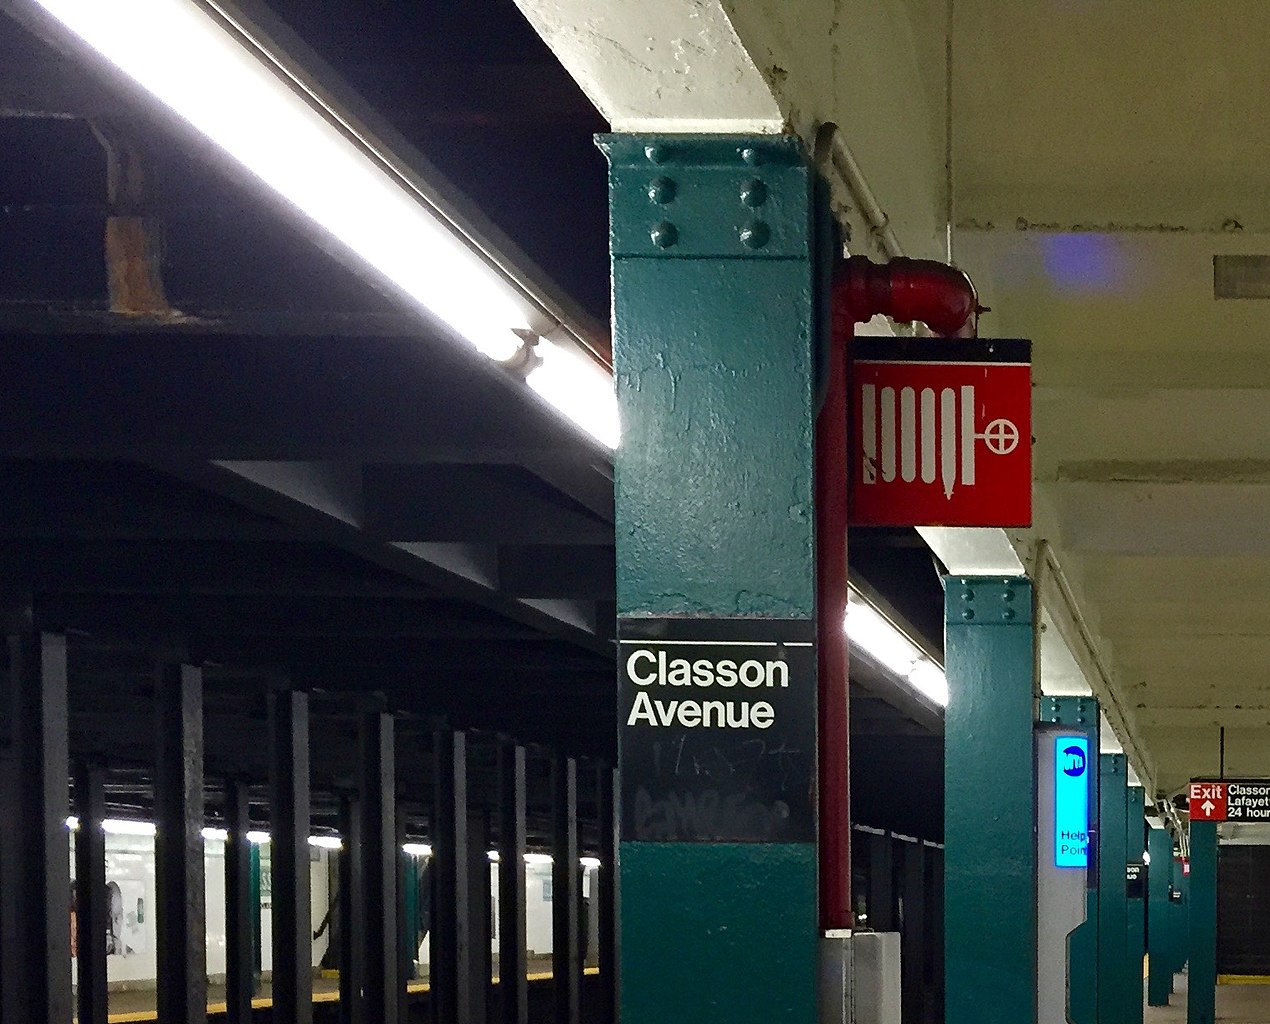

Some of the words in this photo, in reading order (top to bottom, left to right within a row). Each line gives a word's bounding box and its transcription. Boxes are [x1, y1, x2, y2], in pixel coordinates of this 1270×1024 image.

[626, 649, 789, 688] Classon
[626, 691, 775, 729] Avenue
[1190, 784, 1222, 799] Exit
[1228, 808, 1242, 817] 24
[1246, 808, 1270, 817] hour
[1061, 830, 1087, 842] Help
